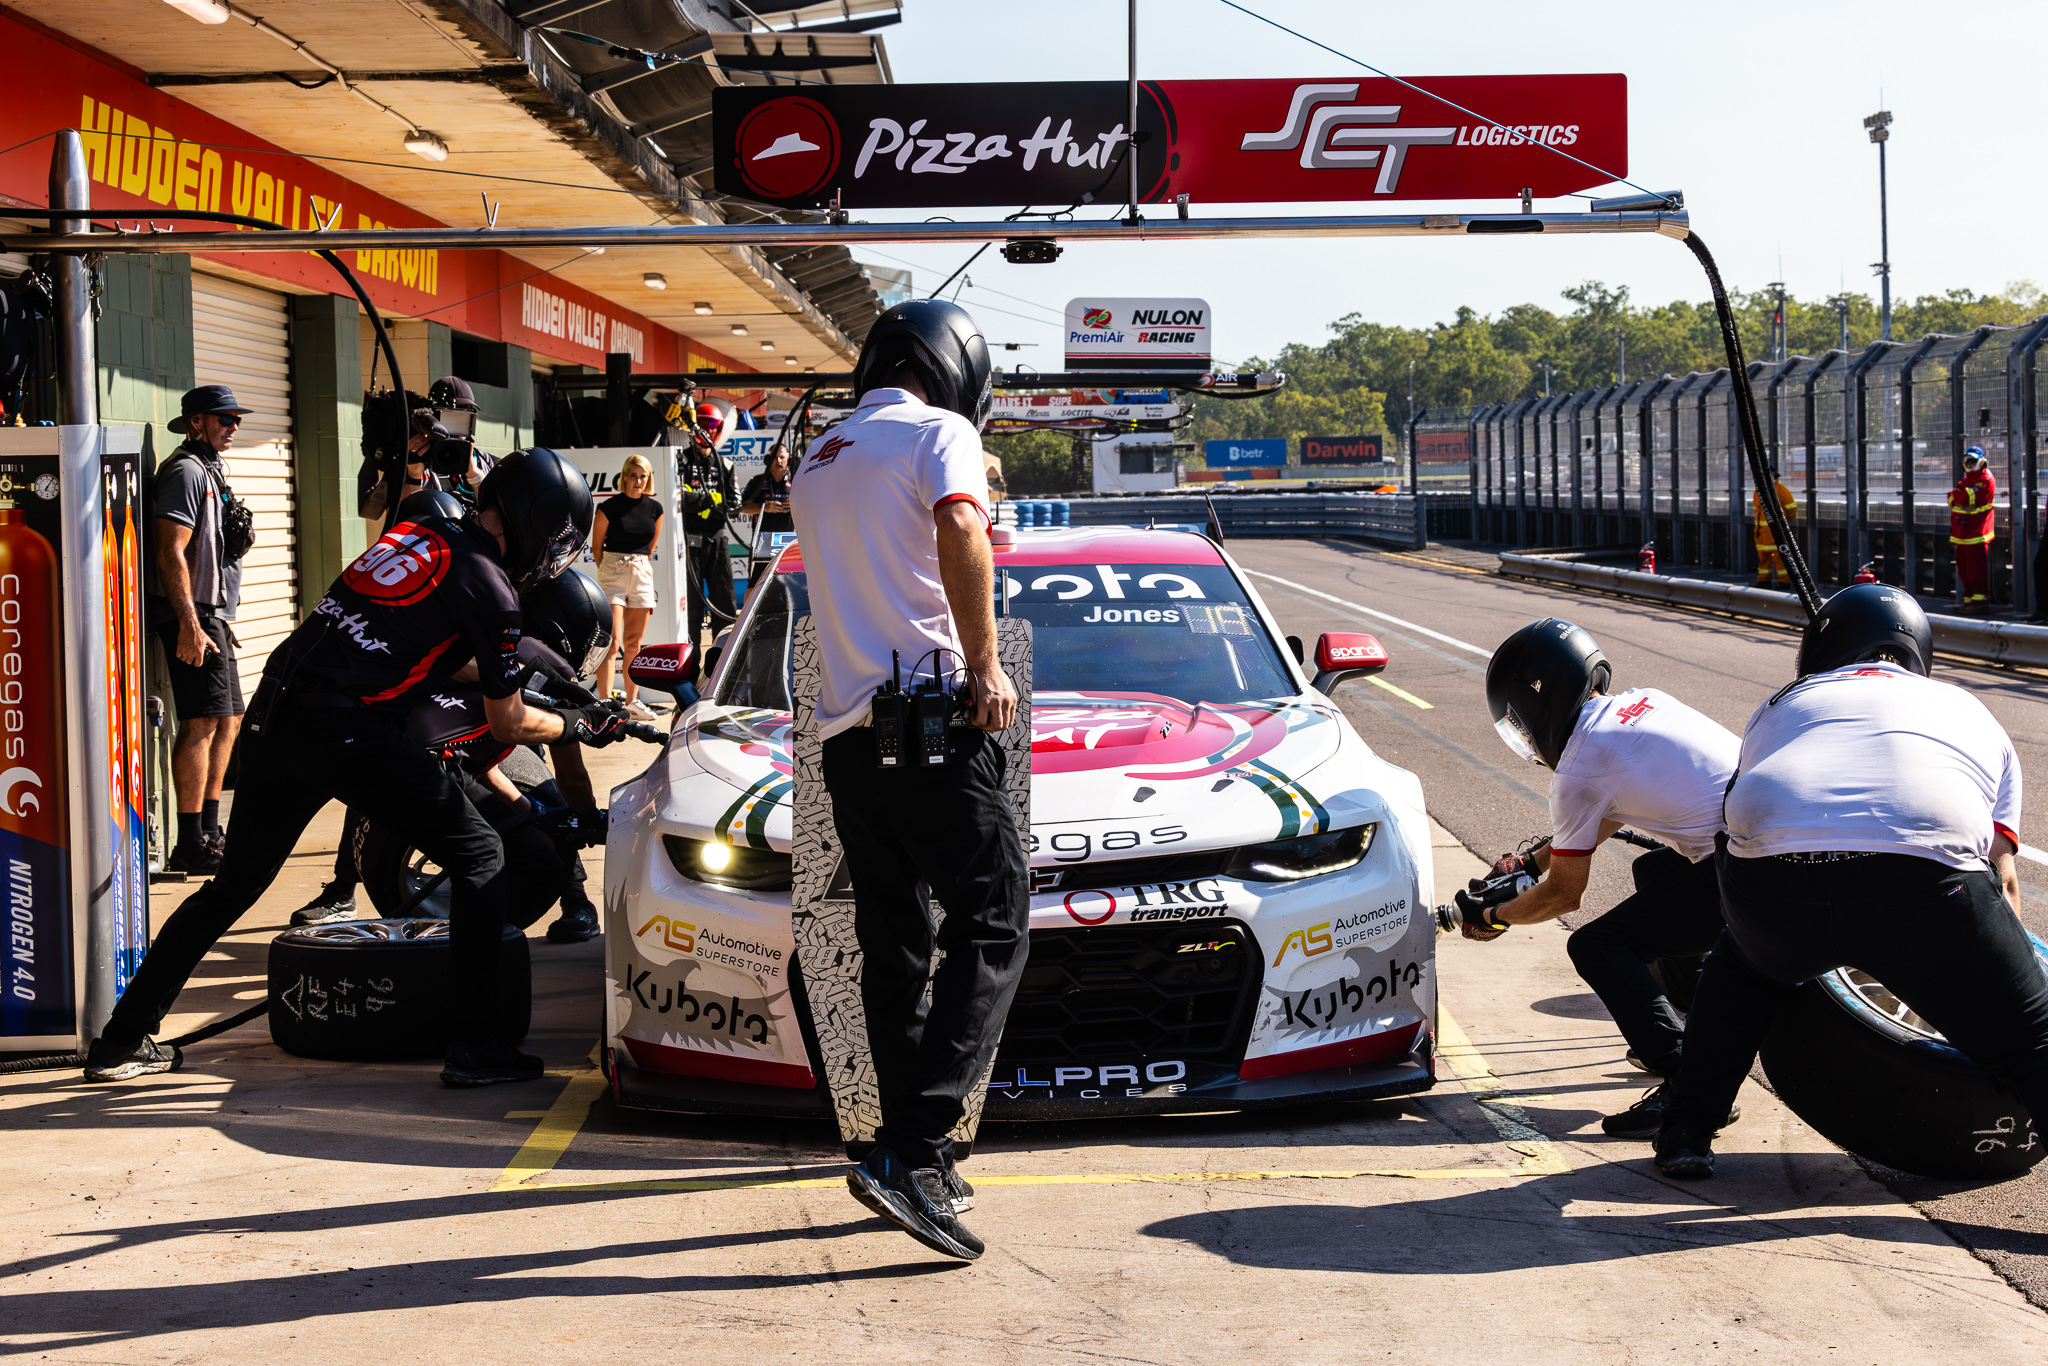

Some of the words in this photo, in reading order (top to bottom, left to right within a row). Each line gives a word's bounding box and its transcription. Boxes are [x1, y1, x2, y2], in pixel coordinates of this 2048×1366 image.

[854, 117, 1013, 180] Pizza
[1018, 116, 1130, 171] Hut
[1239, 83, 1458, 195] SCT
[1456, 125, 1580, 147] LOGISTICS
[80, 94, 223, 213] HIDDEN
[357, 213, 438, 296] DARWIN
[522, 282, 566, 339] HIDDEN
[568, 301, 607, 352] VALLEY
[610, 318, 644, 365] DARWIN
[1131, 310, 1204, 326] NULON
[1069, 331, 1126, 344] PremiAir
[1137, 331, 1197, 344] RACING
[1240, 447, 1265, 459] betr
[1306, 440, 1378, 459] Darwin
[353, 542, 419, 586] 96
[1083, 605, 1180, 623] Jones
[337, 612, 392, 655] Hut
[0, 573, 25, 760] coregas
[631, 656, 680, 671] sparco
[1121, 878, 1225, 907] TRG
[9, 858, 35, 964] NITROGEN
[1130, 903, 1229, 923] transport
[636, 914, 697, 953] AS
[698, 928, 782, 960] Automotive
[1176, 941, 1219, 954] ZL1
[1272, 921, 1333, 968] AS
[1334, 899, 1407, 933] Automotive
[1336, 914, 1408, 948] SUPERSTORE
[696, 947, 780, 977] SUPERSTORE
[13, 966, 36, 1001] 4.0
[1283, 959, 1420, 1029] Kubota
[625, 963, 769, 1045] Kubota
